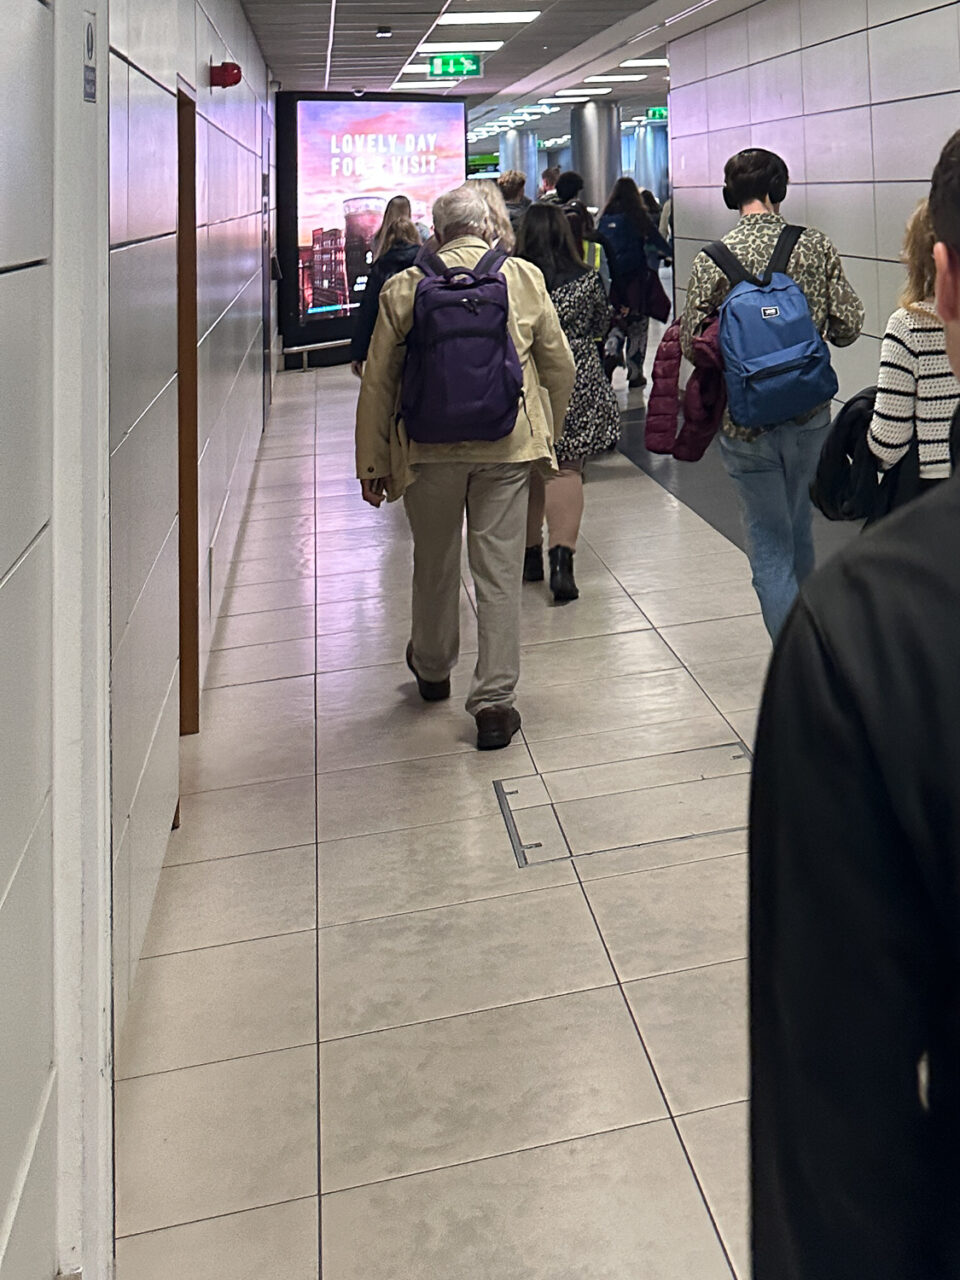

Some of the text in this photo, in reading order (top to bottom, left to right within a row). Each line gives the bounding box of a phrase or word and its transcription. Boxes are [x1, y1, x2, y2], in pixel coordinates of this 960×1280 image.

[331, 133, 437, 154] LOVELY DAY
[391, 155, 437, 175] VISIT
